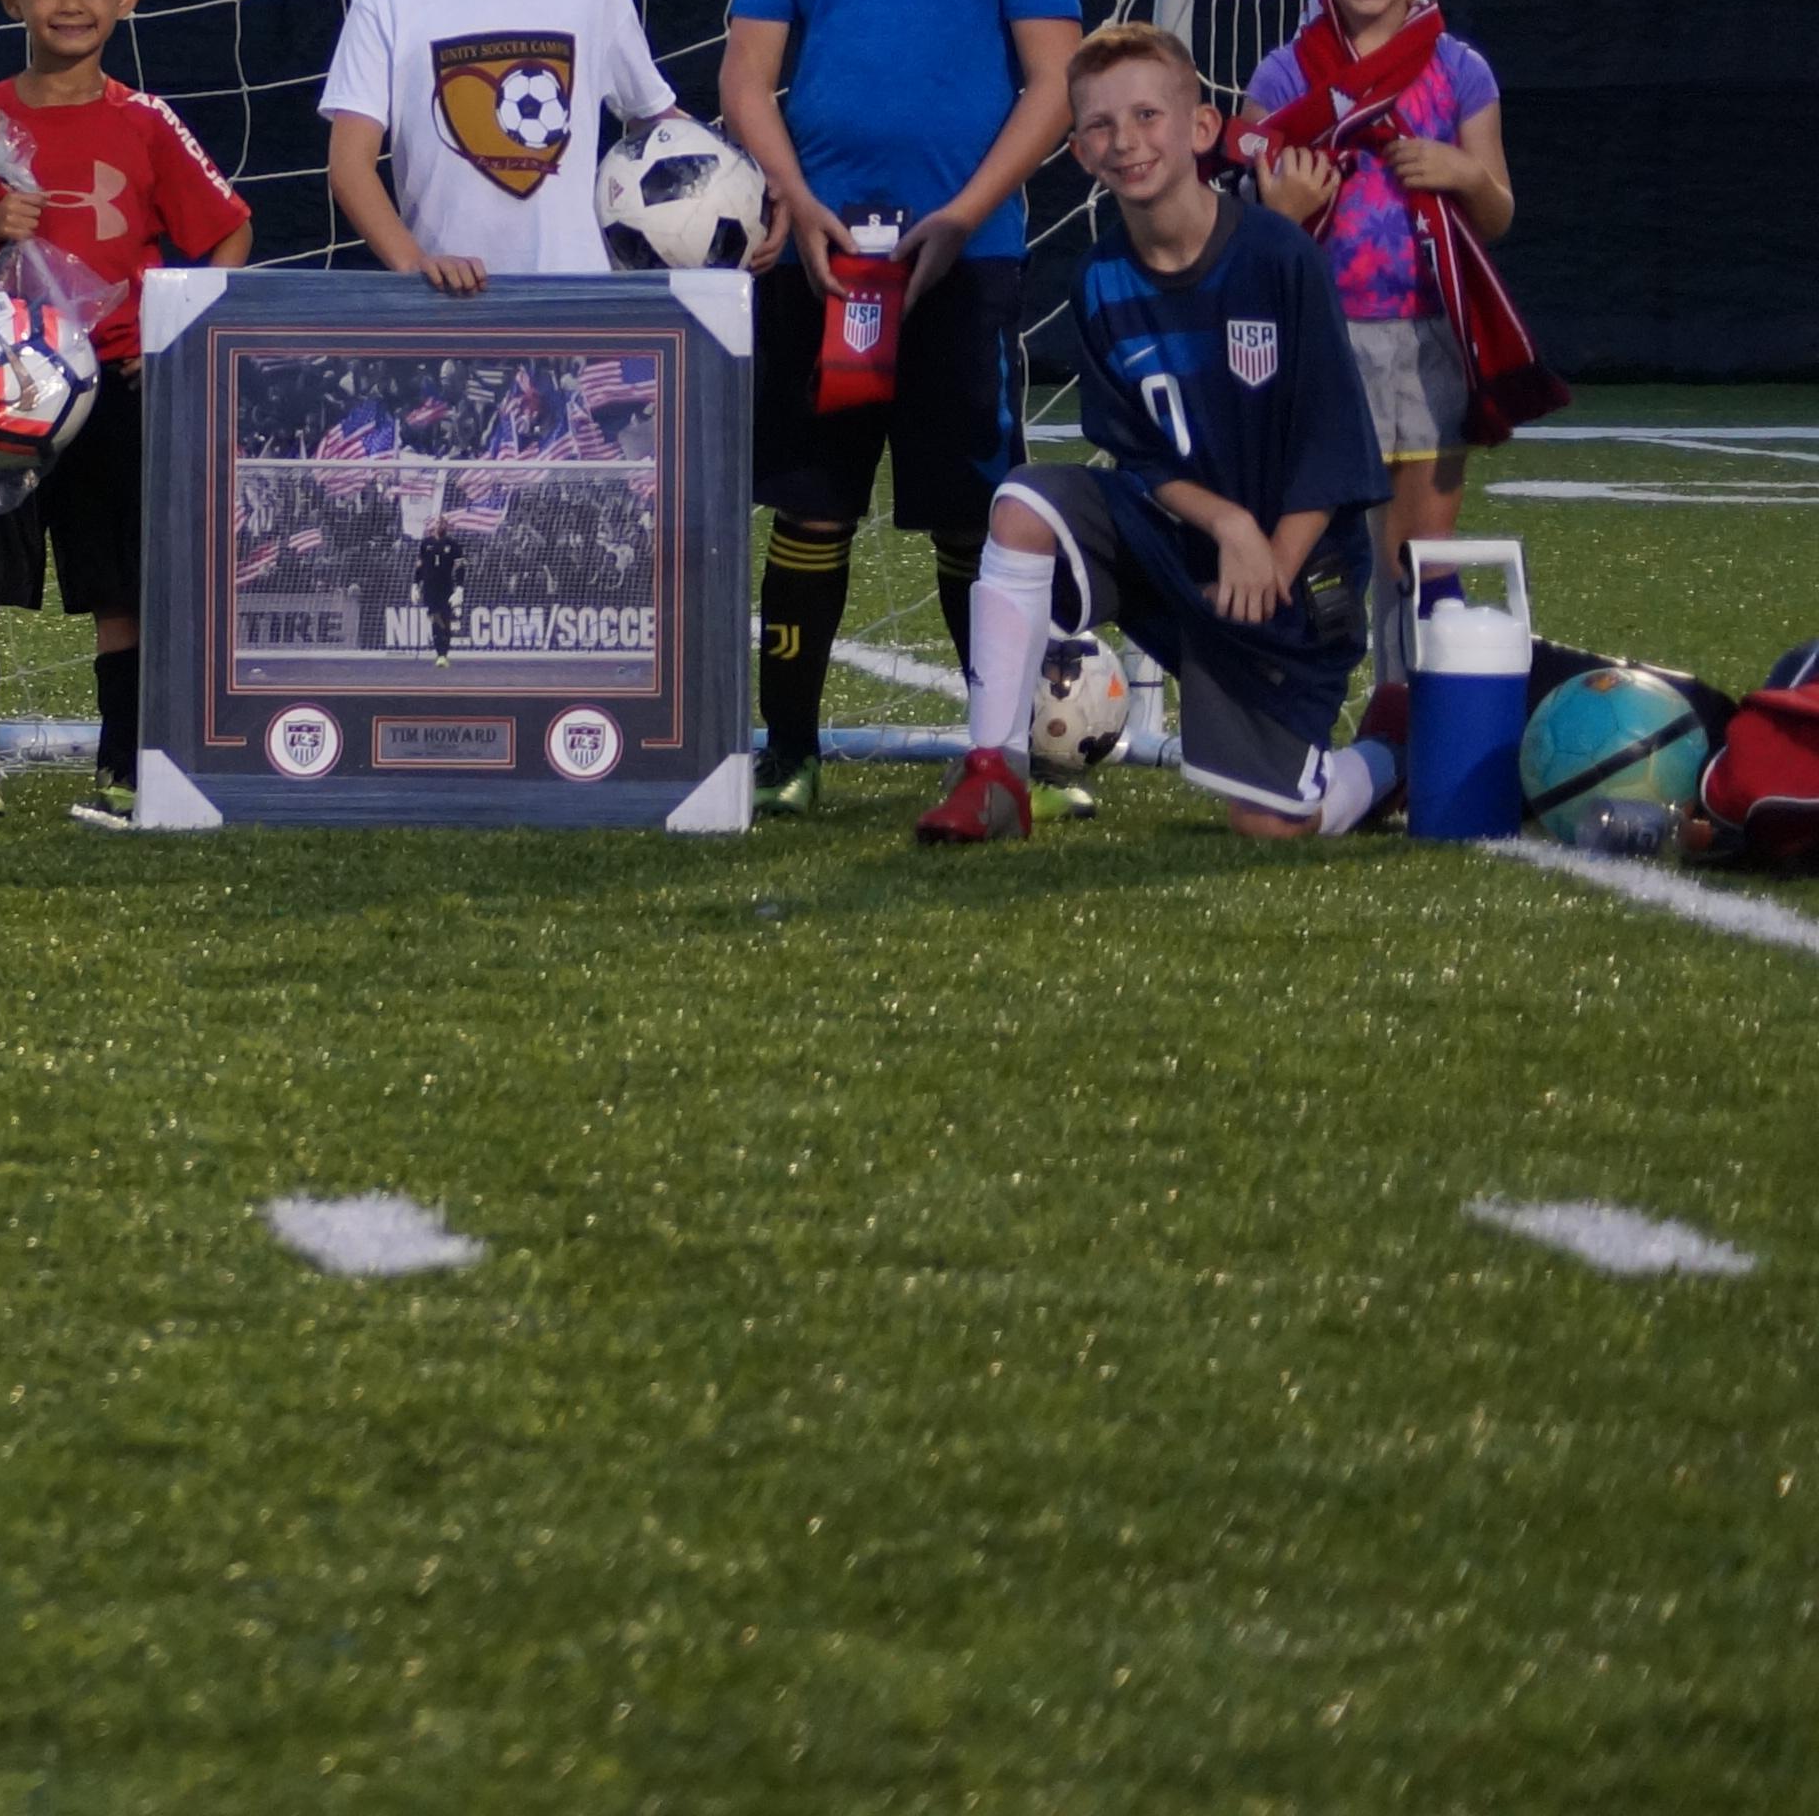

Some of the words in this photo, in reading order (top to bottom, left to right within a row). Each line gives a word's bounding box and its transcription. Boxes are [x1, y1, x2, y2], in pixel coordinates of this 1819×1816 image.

[481, 40, 528, 56] SOCCER
[848, 305, 880, 324] USA
[1231, 323, 1273, 347] USA
[388, 727, 418, 744] TIM
[424, 726, 497, 744] HOWARD
